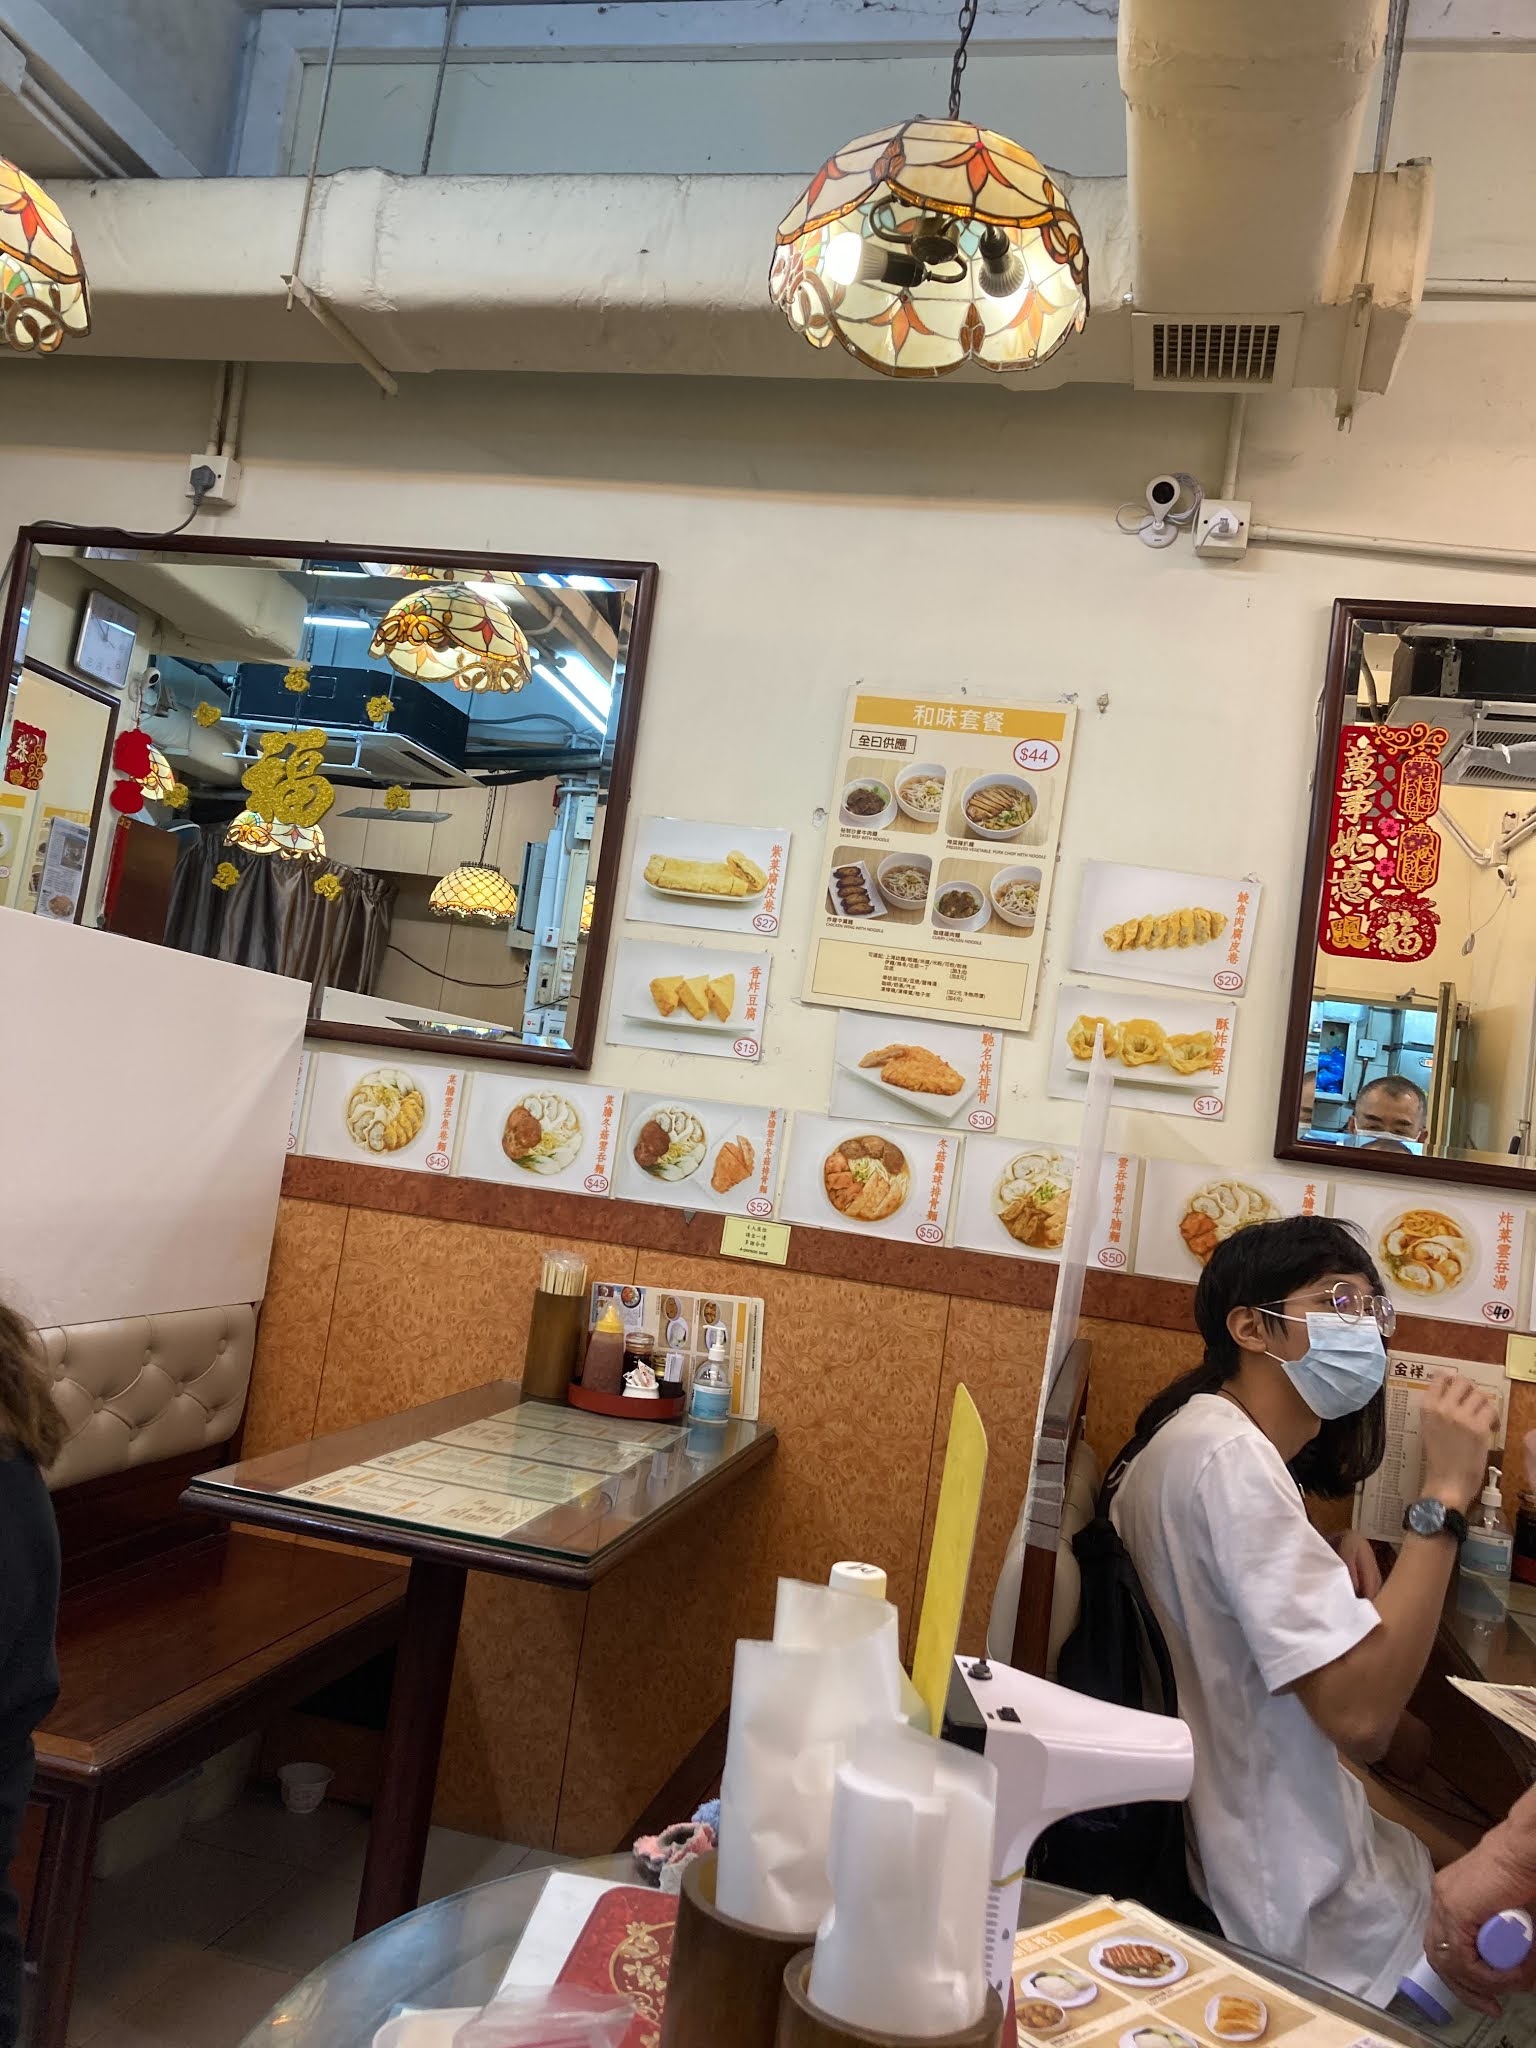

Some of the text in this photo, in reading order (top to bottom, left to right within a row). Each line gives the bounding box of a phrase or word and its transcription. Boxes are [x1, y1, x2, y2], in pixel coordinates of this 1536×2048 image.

[913, 705, 1005, 733] 和味套餐
[858, 735, 908, 750] 全日供應
[1019, 748, 1048, 763] $44
[756, 917, 775, 929] $27
[1217, 975, 1239, 986] $20
[744, 966, 762, 1021] 香炸豆腐
[736, 1042, 755, 1053] $15
[1209, 1018, 1229, 1075] 酥炸雲吞
[978, 1033, 994, 1104] 馳名炸排骨
[1197, 1100, 1219, 1111] $17
[971, 1114, 992, 1126] $30
[429, 1156, 447, 1167] $45
[587, 1178, 606, 1189] $45
[749, 1201, 769, 1213] $52
[919, 1227, 940, 1240] $50
[1492, 1211, 1514, 1291] 炸菜雲吞湯
[1101, 1252, 1123, 1264] $50
[1486, 1304, 1510, 1320] $40
